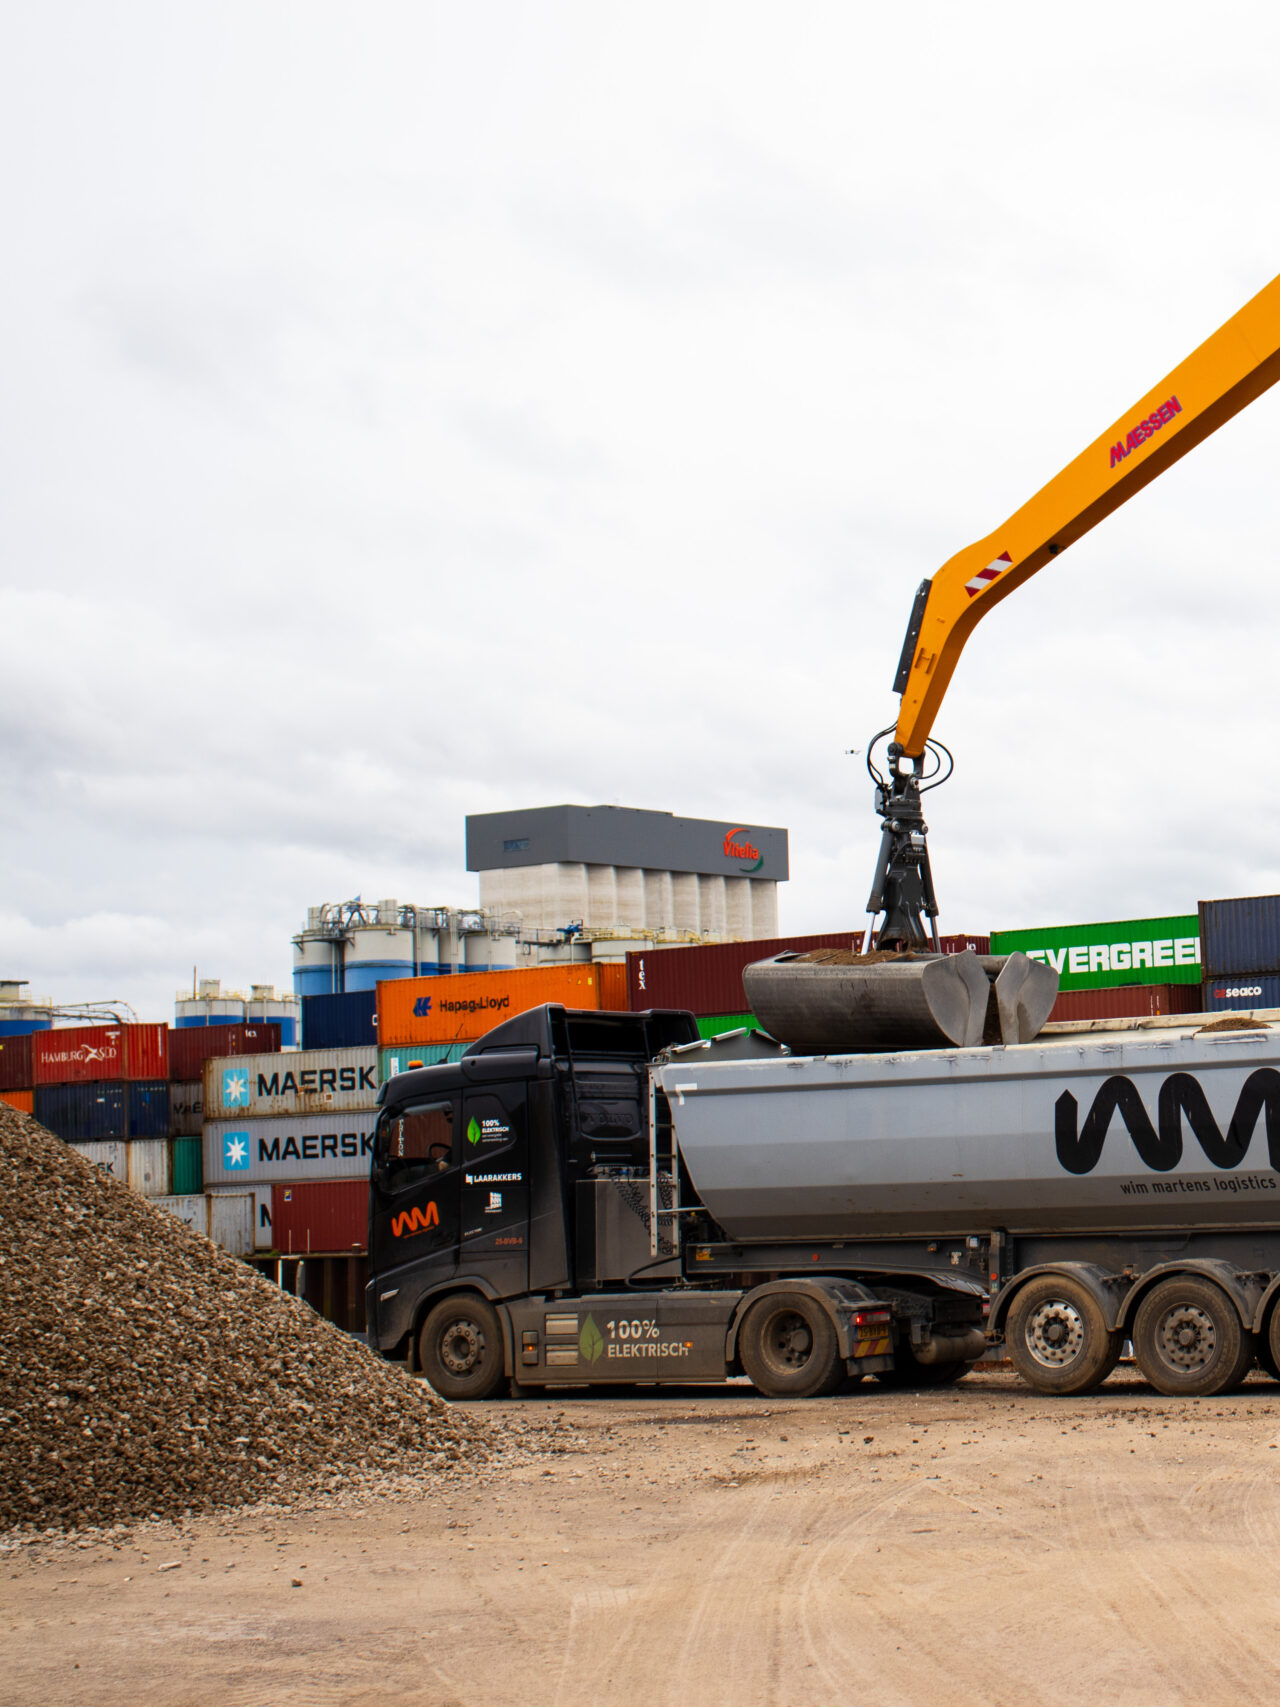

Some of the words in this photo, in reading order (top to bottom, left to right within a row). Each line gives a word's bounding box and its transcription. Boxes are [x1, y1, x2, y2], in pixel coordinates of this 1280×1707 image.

[1110, 395, 1183, 468] MAESSEN
[723, 840, 759, 860] Vitelia
[1225, 986, 1262, 998] seaco
[440, 996, 509, 1013] Hapag-Lloyd
[41, 1050, 84, 1063] HAMBURG
[257, 1066, 377, 1097] MAERSK
[258, 1132, 375, 1162] MAERSK
[474, 1172, 522, 1183] LAARAKKERS
[1120, 1181, 1149, 1195] wim
[1152, 1178, 1211, 1193] martens
[1213, 1176, 1277, 1193] logistics
[606, 1319, 660, 1340] 100%
[607, 1342, 690, 1358] ELEKTRISCH
